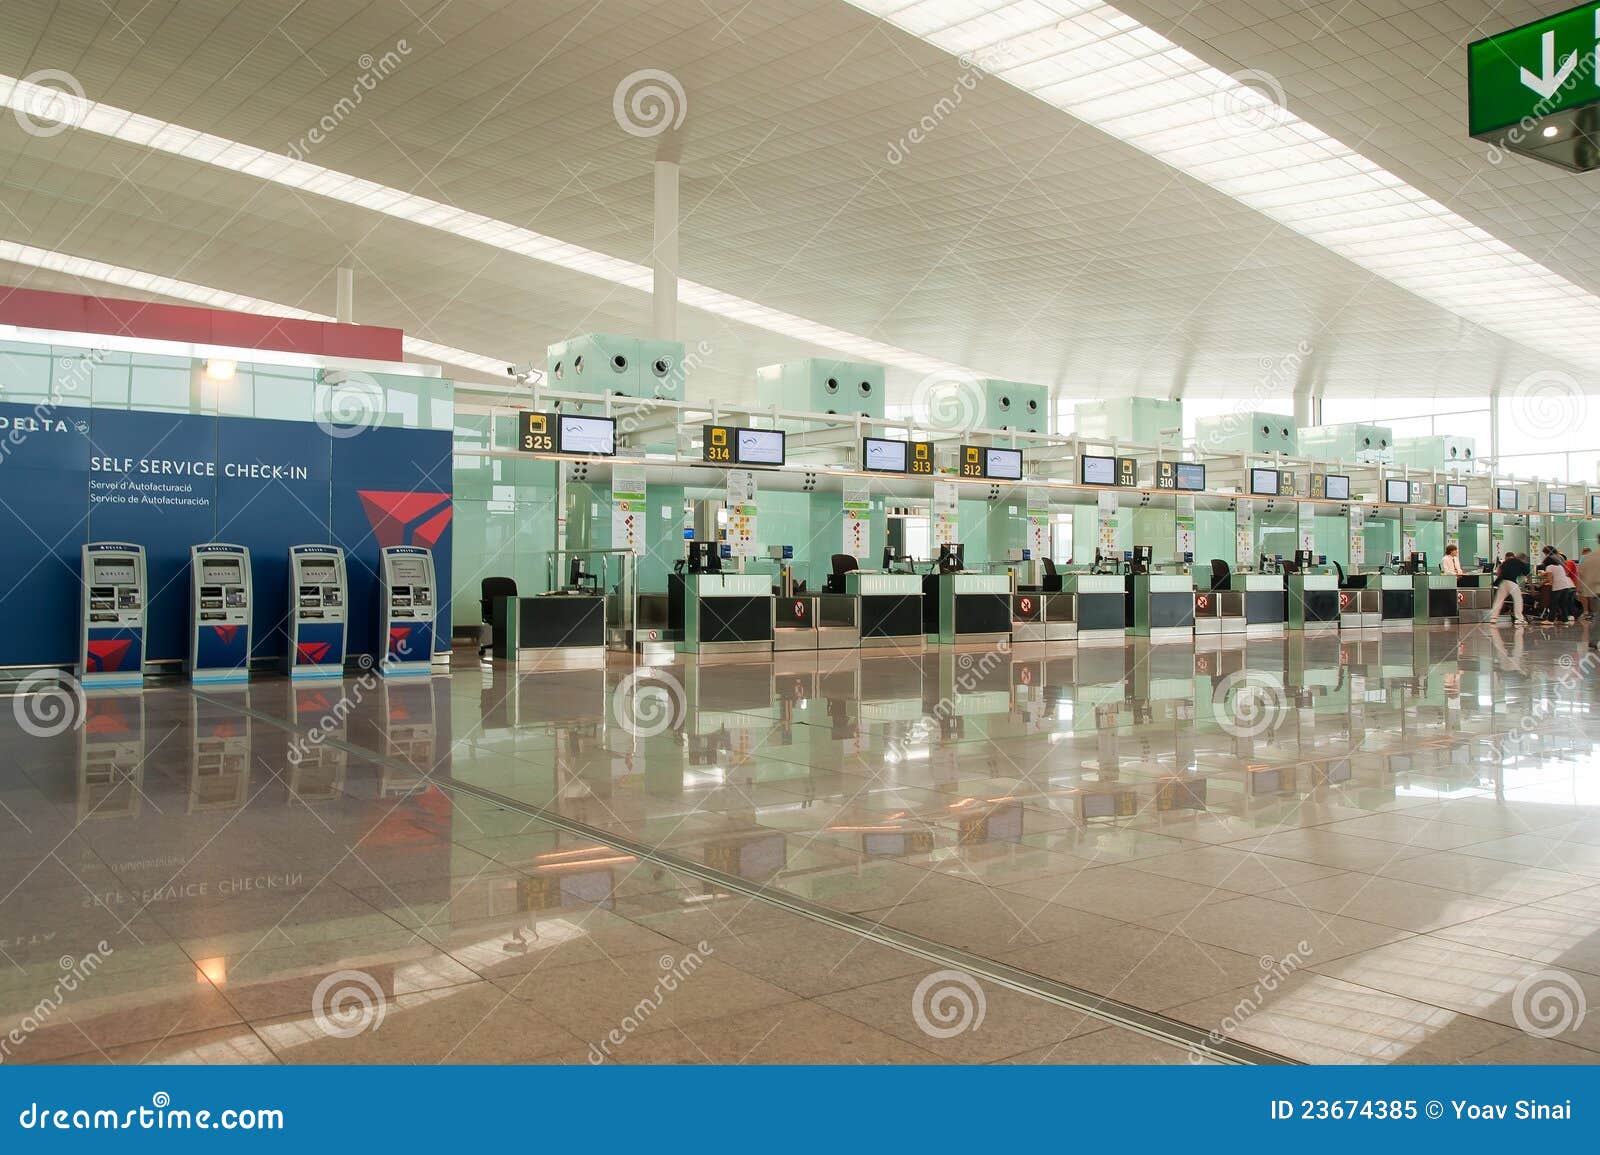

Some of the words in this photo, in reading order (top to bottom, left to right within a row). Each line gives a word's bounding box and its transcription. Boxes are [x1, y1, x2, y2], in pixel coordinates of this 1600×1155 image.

[524, 435, 552, 450] 325
[709, 447, 729, 460] 314
[90, 456, 133, 473] SELF
[139, 459, 215, 477] SERVICE
[224, 463, 308, 481] CHECK-IN
[912, 460, 931, 473] 313
[963, 464, 981, 476] 312
[90, 480, 118, 490] Servei
[1120, 475, 1134, 486] 311
[1159, 477, 1173, 488] 310
[90, 493, 126, 504] Servicio
[127, 495, 139, 504] de
[141, 495, 210, 507] Autofacturación
